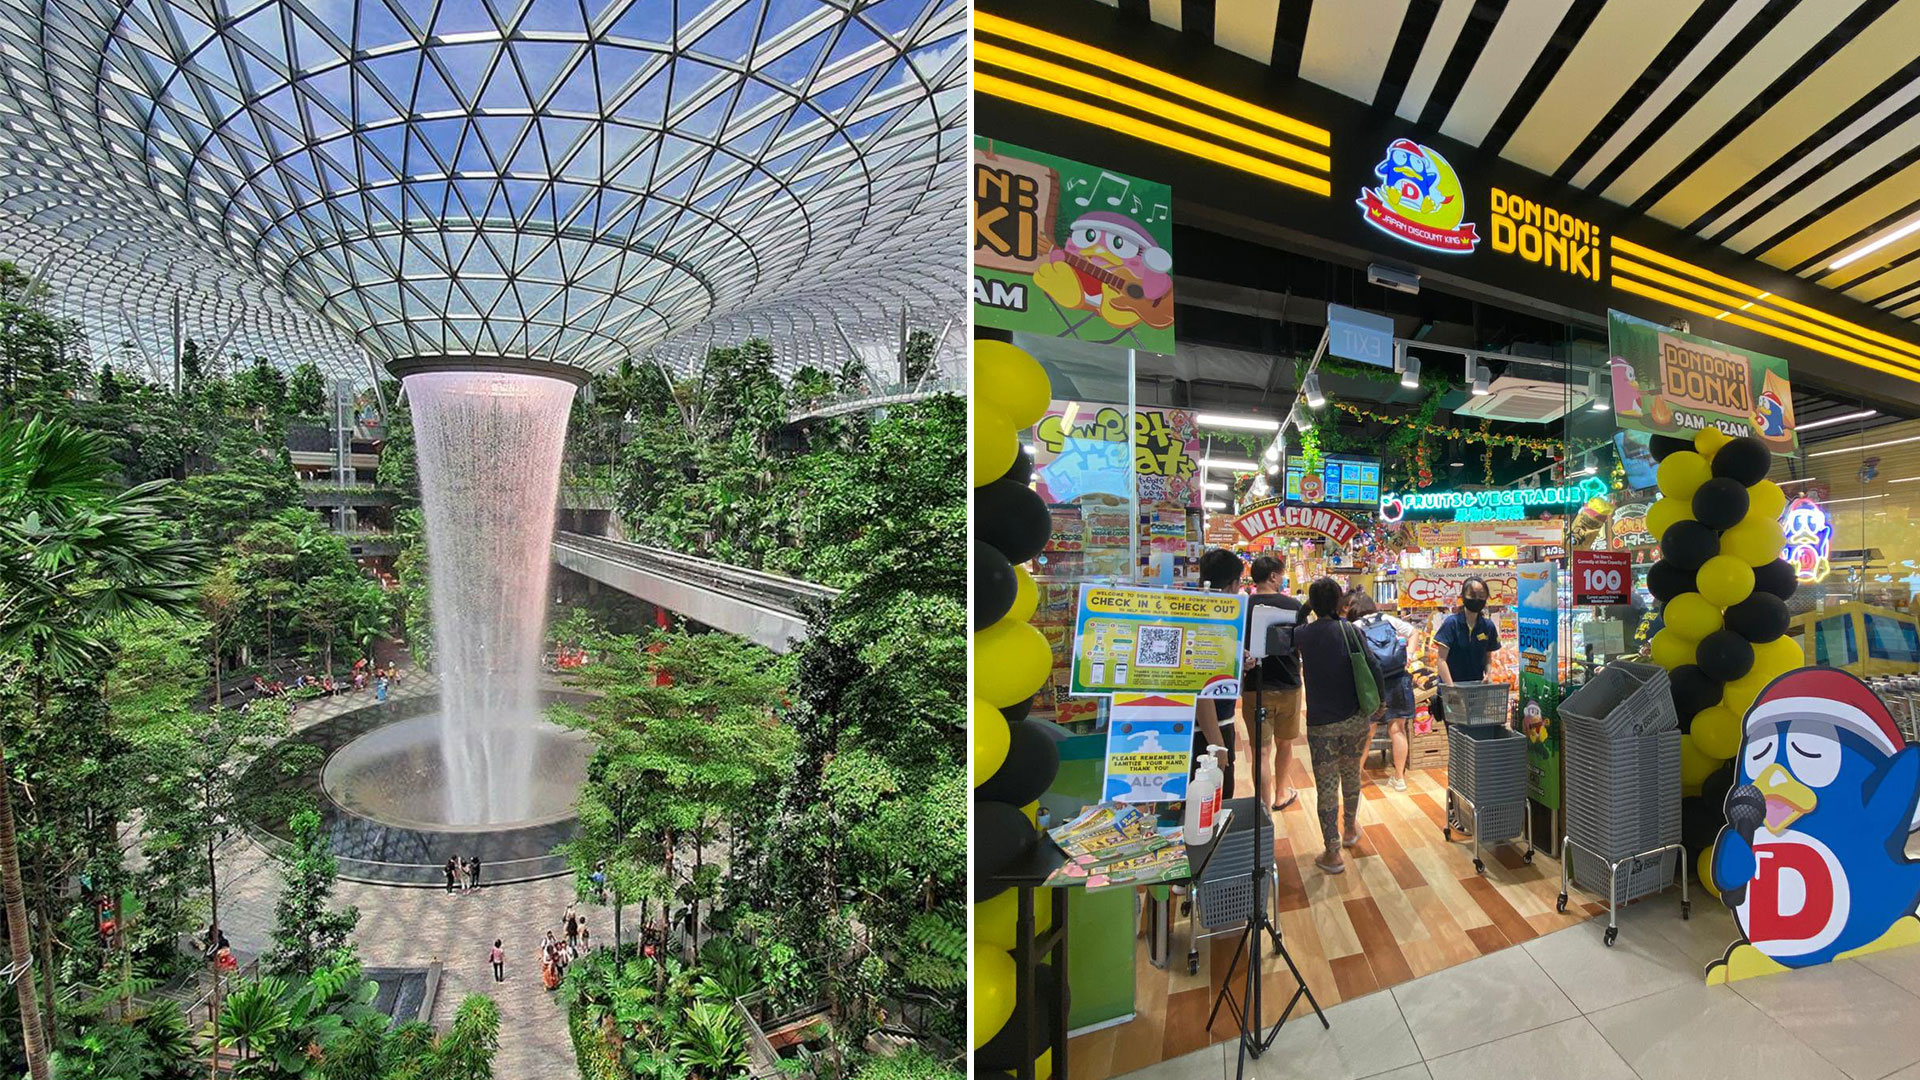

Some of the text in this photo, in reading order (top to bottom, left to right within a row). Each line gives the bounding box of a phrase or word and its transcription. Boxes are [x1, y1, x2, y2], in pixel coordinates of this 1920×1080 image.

[1401, 182, 1420, 200] D
[1491, 187, 1542, 227] DON
[1382, 215, 1460, 244] JAPAN DISCOUNT KING
[1491, 214, 1600, 282] DONKI
[1664, 343, 1701, 371] DON
[1665, 366, 1749, 412] DONKI
[1674, 411, 1706, 430] 9AM
[1715, 419, 1749, 438] 12AM
[1402, 487, 1582, 509] FRUITS & VEGETABLE
[1240, 506, 1351, 541] WELCOME!
[1583, 568, 1622, 591] 100
[1091, 596, 1131, 608] CHECK
[1138, 600, 1149, 608] IN
[1169, 602, 1207, 613] CHECK
[1213, 605, 1236, 614] OUT
[1519, 617, 1541, 625] WELCOME
[1519, 635, 1549, 651] DONKI
[1131, 776, 1163, 787] ALC
[1749, 842, 1834, 944] D
